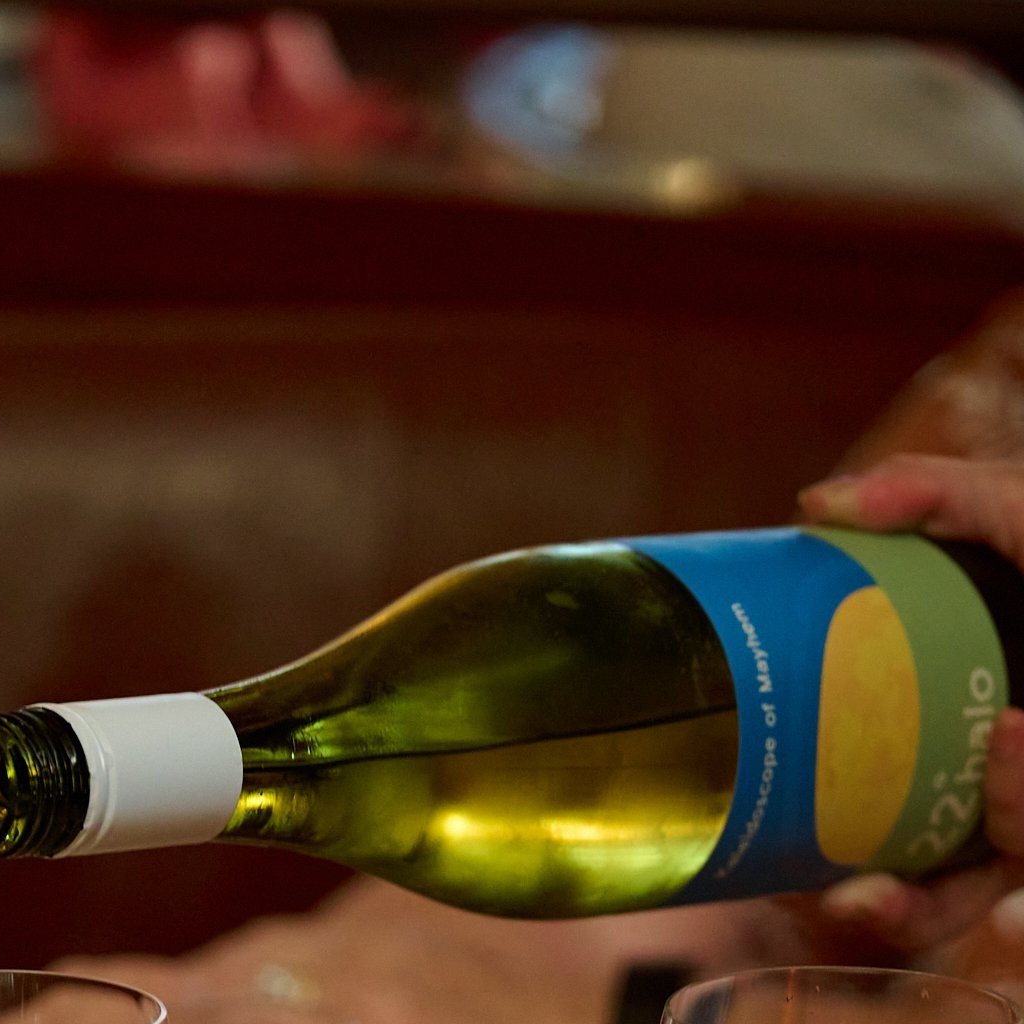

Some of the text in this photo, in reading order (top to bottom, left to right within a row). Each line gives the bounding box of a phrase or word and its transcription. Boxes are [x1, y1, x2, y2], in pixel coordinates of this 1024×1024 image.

[715, 602, 778, 878] doscope of Mayhem
